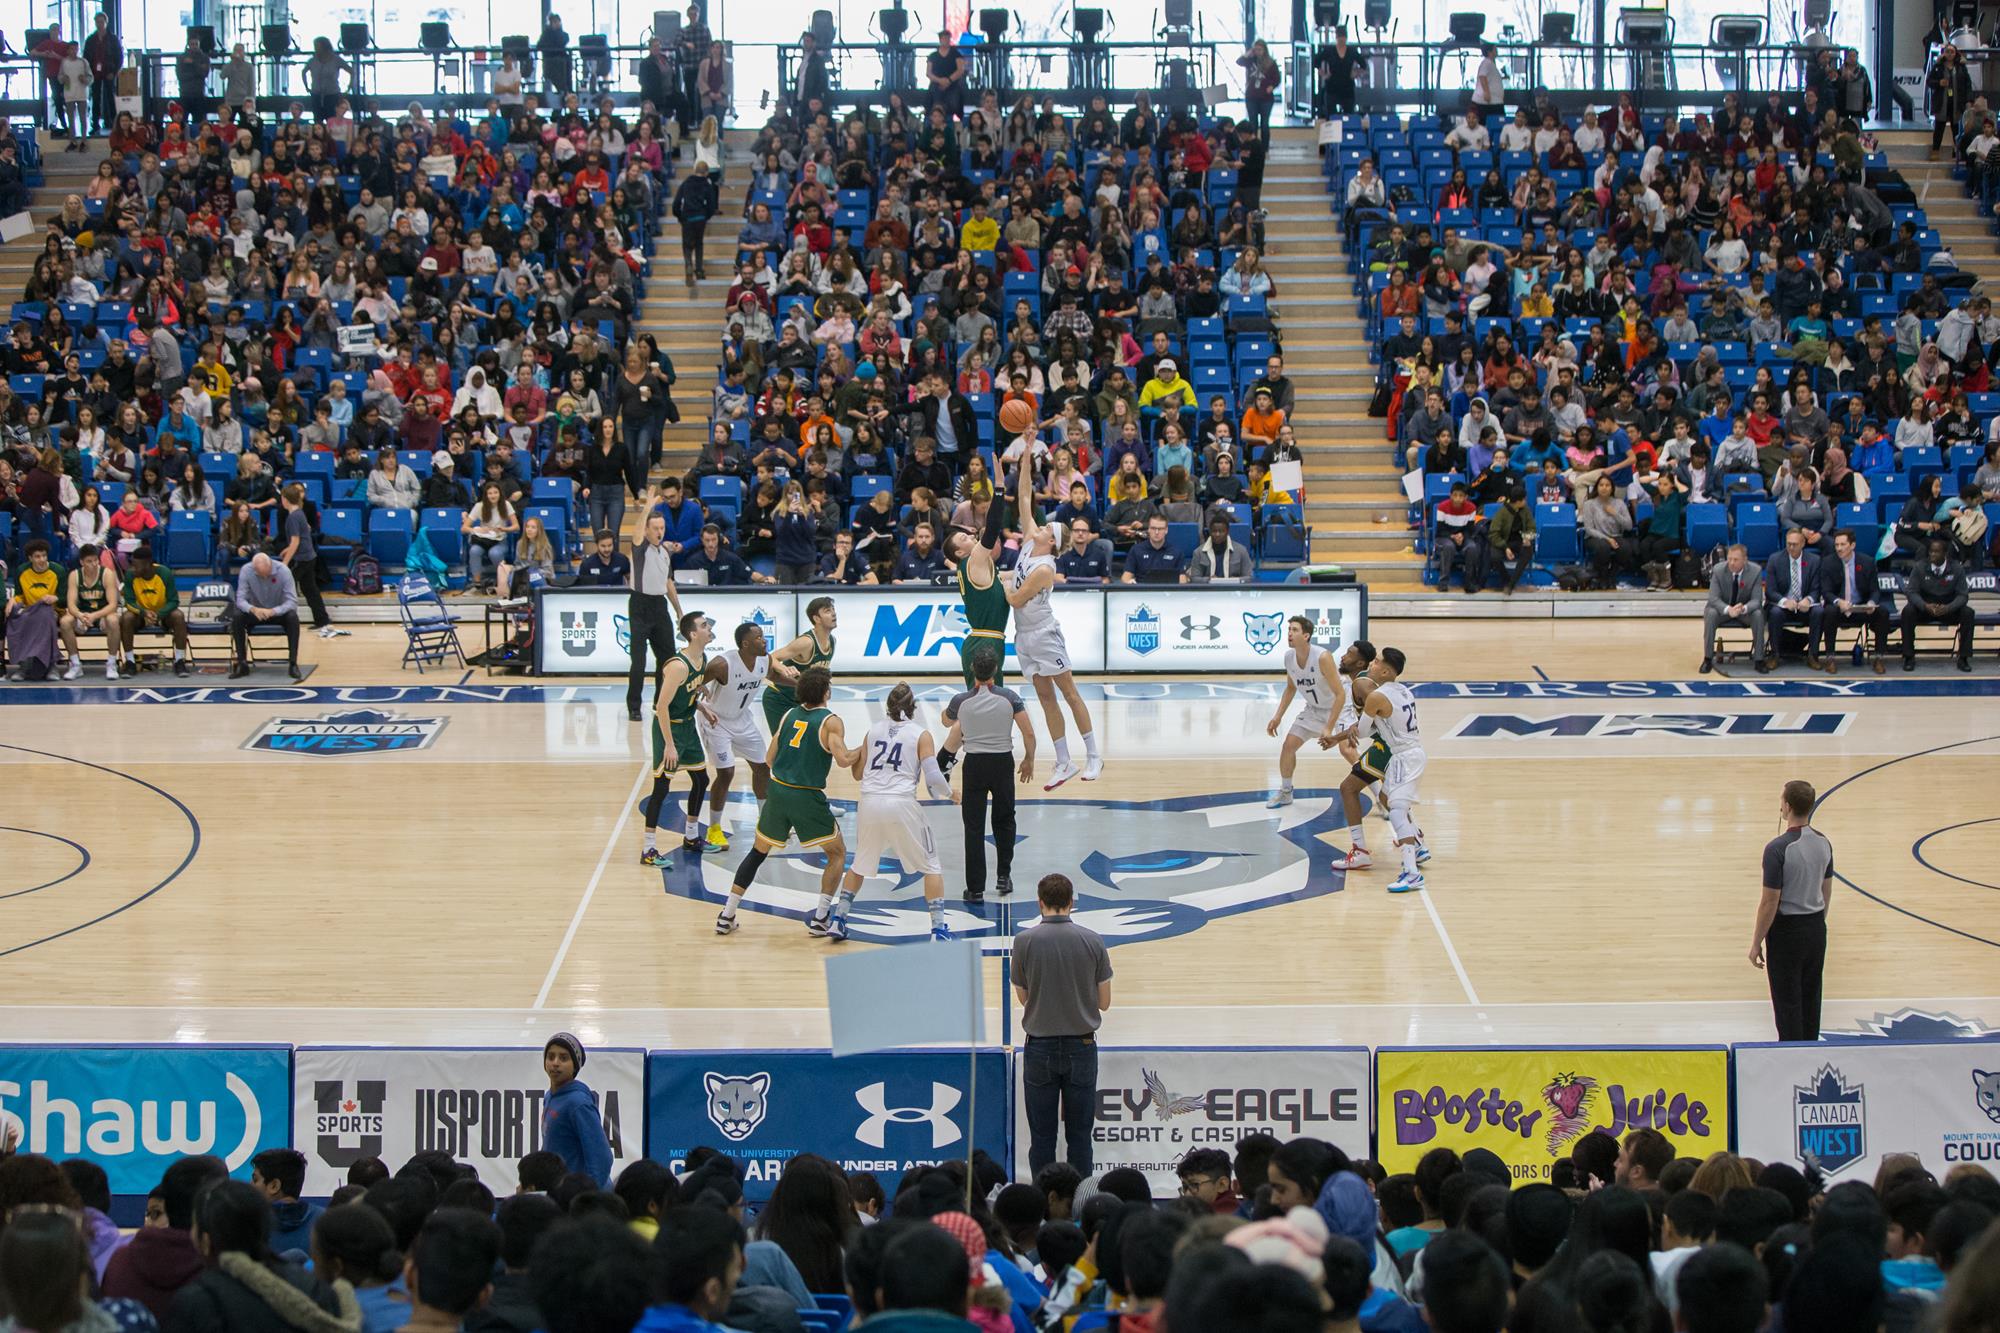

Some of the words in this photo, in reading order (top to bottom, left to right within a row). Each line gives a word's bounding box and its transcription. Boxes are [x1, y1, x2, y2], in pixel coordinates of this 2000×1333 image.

[1966, 576, 1995, 588] MRU
[196, 585, 229, 597] MRU
[562, 630, 596, 638] SPORTS
[1129, 623, 1157, 631] CANADA
[1313, 627, 1341, 635] PORTS
[1130, 634, 1157, 647] WEST
[1056, 659, 1065, 670] 9
[116, 687, 612, 702] MOUNT
[1096, 682, 1876, 697] UNERSITY
[1306, 689, 1318, 705] 7
[740, 693, 749, 709] 1
[1446, 712, 1854, 738] MRU
[270, 736, 418, 749] WEST
[789, 720, 808, 749] 7
[871, 741, 903, 771] 24
[1096, 1089, 1152, 1121] EY
[1206, 1089, 1357, 1133] EAGLE
[1394, 1085, 1542, 1145] Booster
[1801, 1106, 1858, 1123] CANADA
[317, 1116, 382, 1132] SPORTS
[1093, 1127, 1163, 1142] ESORT
[1171, 1128, 1183, 1142] &
[1803, 1128, 1858, 1156] WEST
[837, 1161, 897, 1171] UNDER
